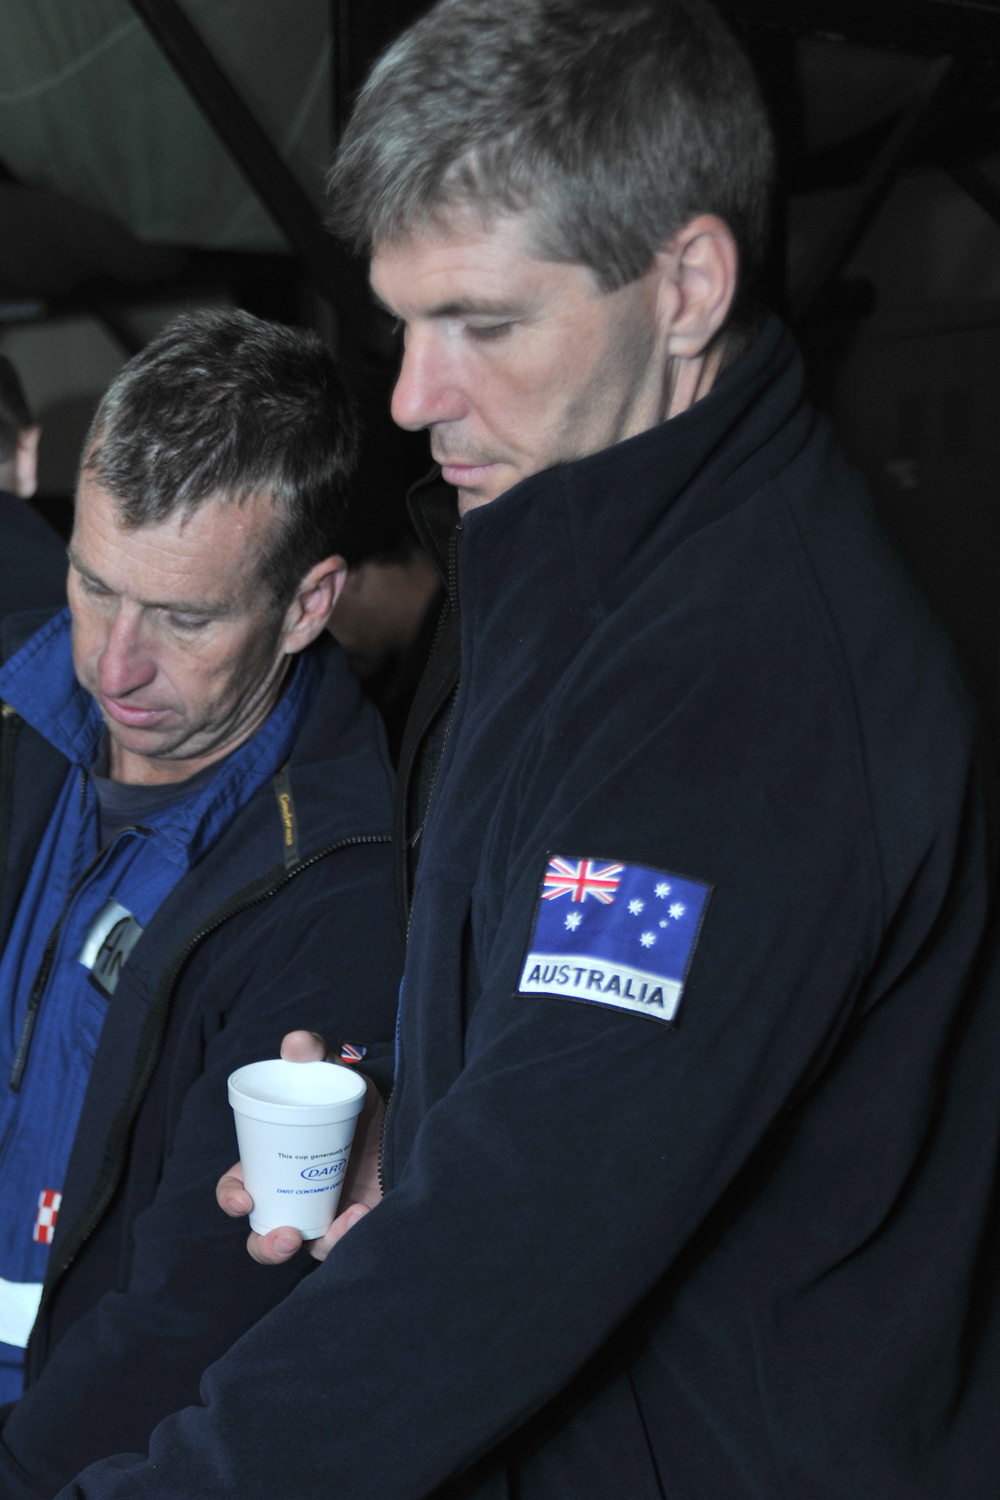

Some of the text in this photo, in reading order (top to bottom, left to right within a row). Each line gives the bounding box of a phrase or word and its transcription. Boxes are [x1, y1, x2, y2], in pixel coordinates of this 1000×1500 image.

[527, 964, 665, 1009] AUSTRALIA
[308, 1162, 344, 1177] DART
[296, 1186, 329, 1194] CONTAINER
